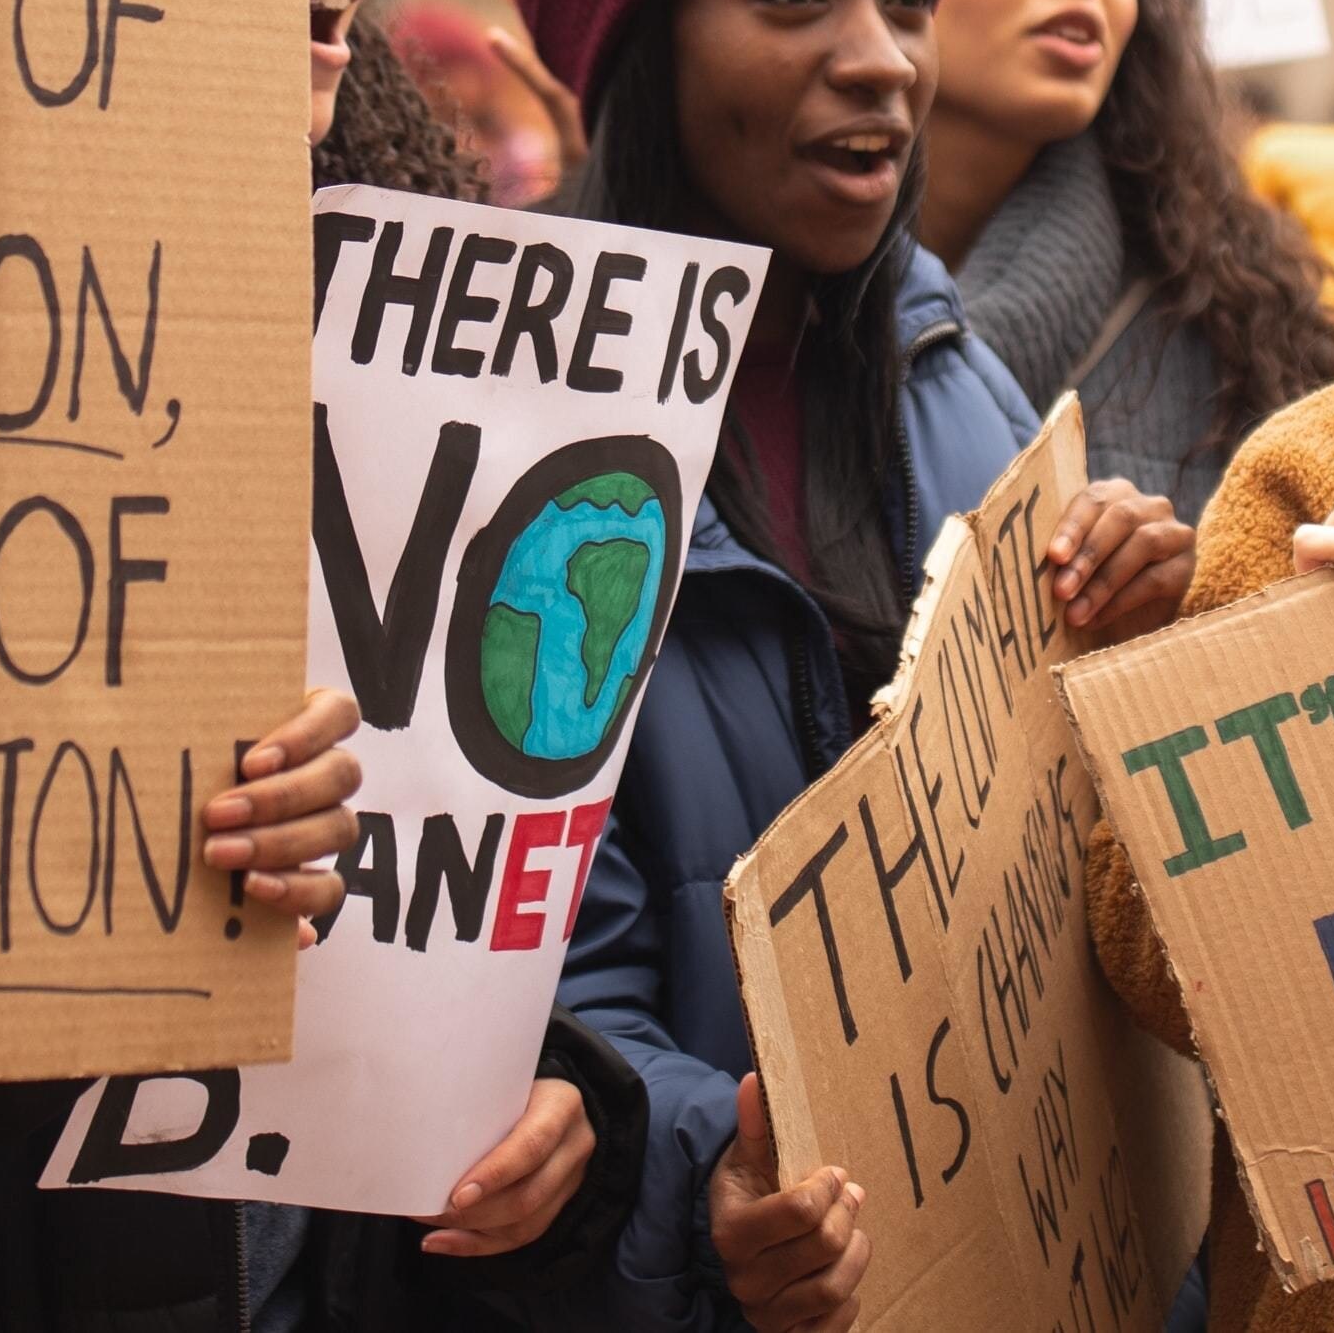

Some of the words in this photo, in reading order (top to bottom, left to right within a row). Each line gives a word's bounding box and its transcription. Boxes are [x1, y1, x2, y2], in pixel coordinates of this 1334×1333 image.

[312, 210, 649, 394] THERE
[656, 260, 753, 406] IS
[310, 400, 684, 800] NO
[768, 693, 967, 1046] THE
[935, 482, 1058, 831] CLIMATE
[312, 795, 613, 955] ANET
[889, 1016, 971, 1209] IS
[1017, 1037, 1081, 1270] WHY
